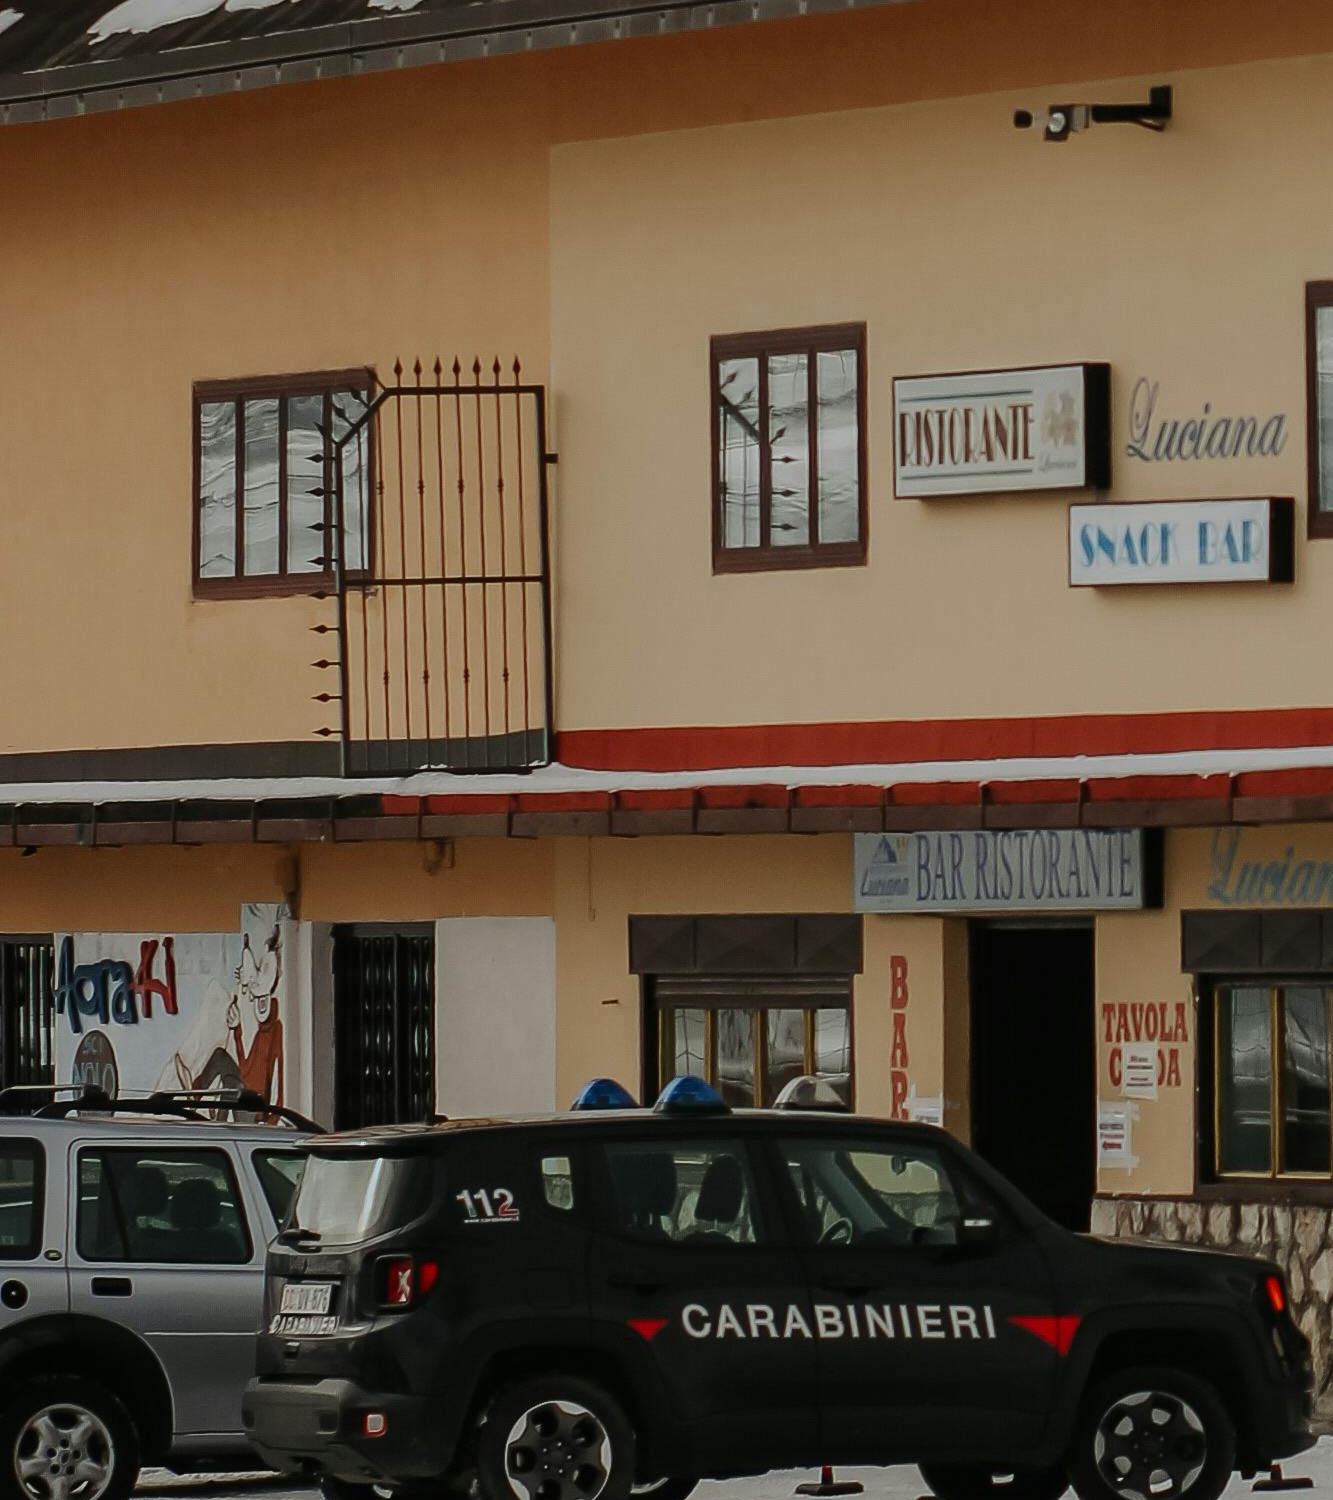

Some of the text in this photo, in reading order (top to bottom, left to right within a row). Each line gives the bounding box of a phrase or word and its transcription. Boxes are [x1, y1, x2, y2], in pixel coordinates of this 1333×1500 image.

[899, 402, 1035, 468] RISTORANTE
[1127, 376, 1288, 462] Luciana
[1080, 519, 1262, 568] SNACK BAR
[915, 828, 1134, 902] BAR RISTORANTE
[889, 955, 909, 1121] BAR
[1102, 1002, 1188, 1042] TAVOLA
[1109, 1048, 1182, 1088] CDA
[456, 1188, 521, 1217] 112
[681, 1303, 997, 1339] CARABINIERI
